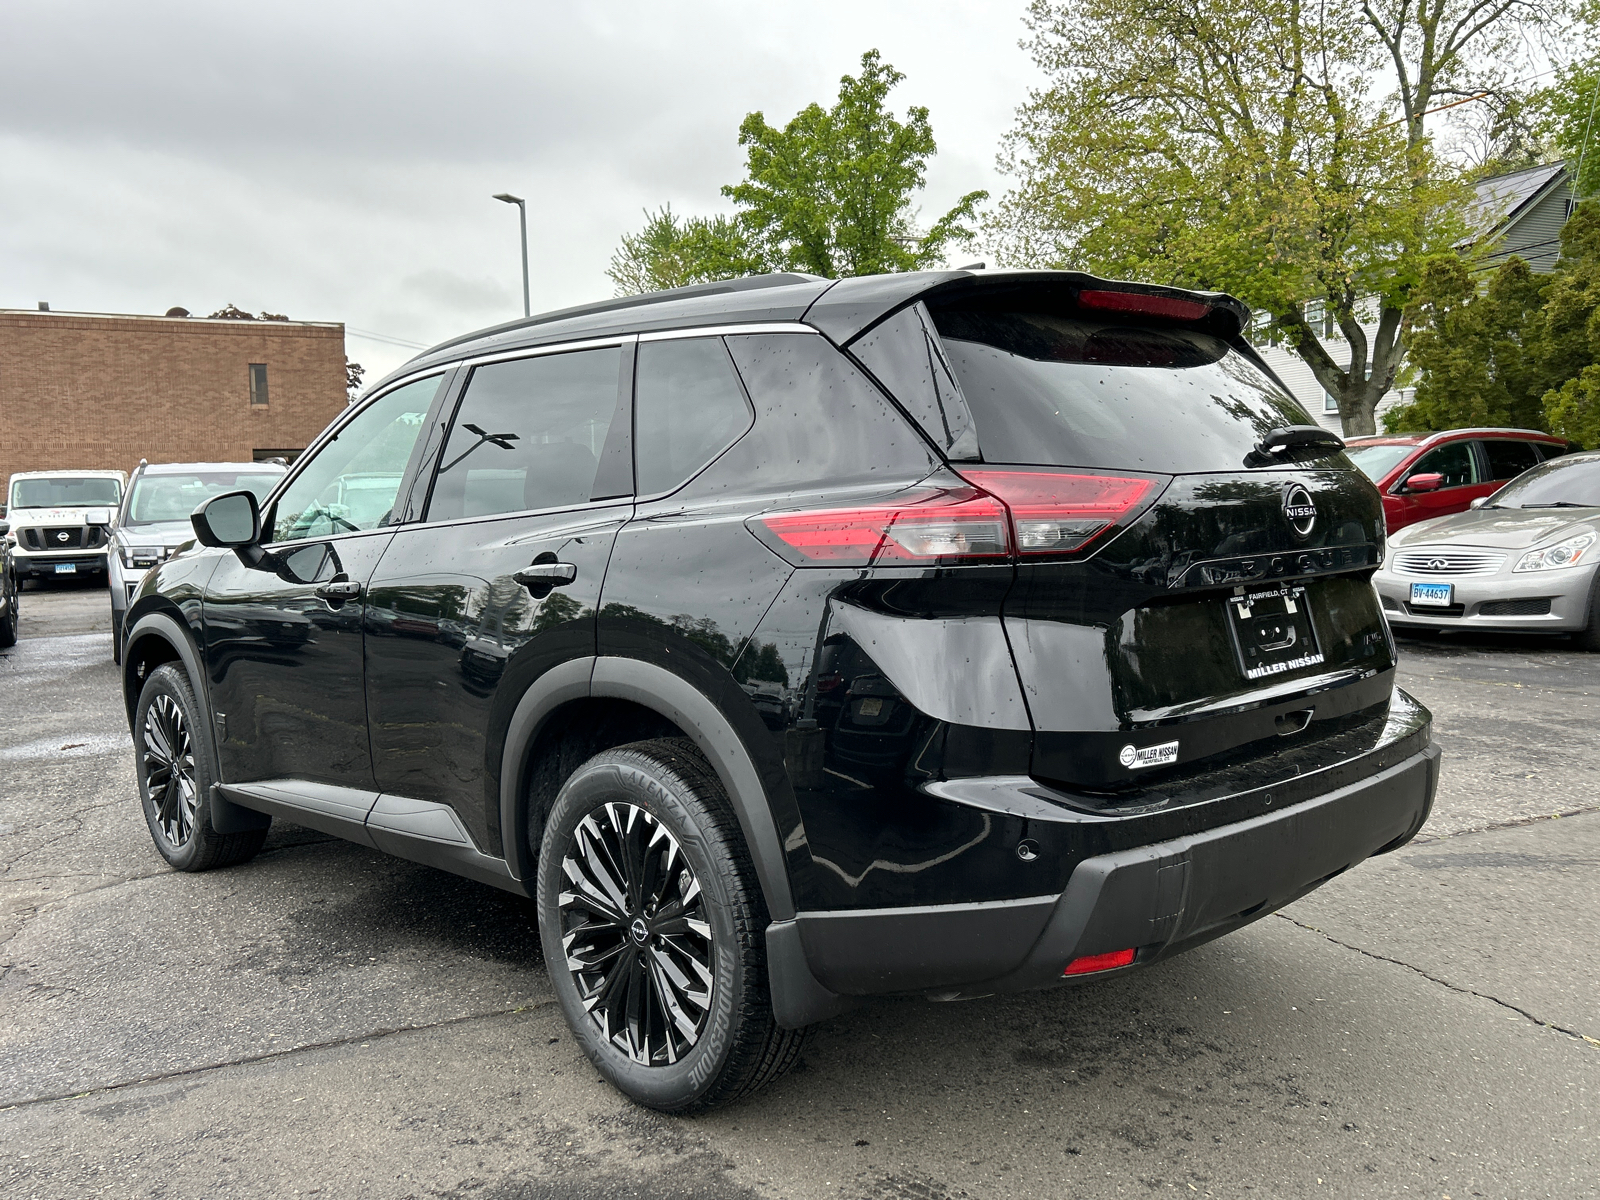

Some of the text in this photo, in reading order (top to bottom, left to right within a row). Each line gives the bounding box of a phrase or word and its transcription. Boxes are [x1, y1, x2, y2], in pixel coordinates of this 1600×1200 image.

[1286, 507, 1318, 517] NISSAN
[1248, 588, 1288, 600] FAIRFIELD, CT
[1413, 587, 1449, 600] BV-44637
[1247, 653, 1325, 680] MILLER NISSAN
[1137, 745, 1178, 761] MILLER NISSAN
[627, 770, 688, 829] ALENZA
[537, 793, 572, 926] BRIDGESTONE
[687, 946, 736, 1091] BRIDGESTONE
